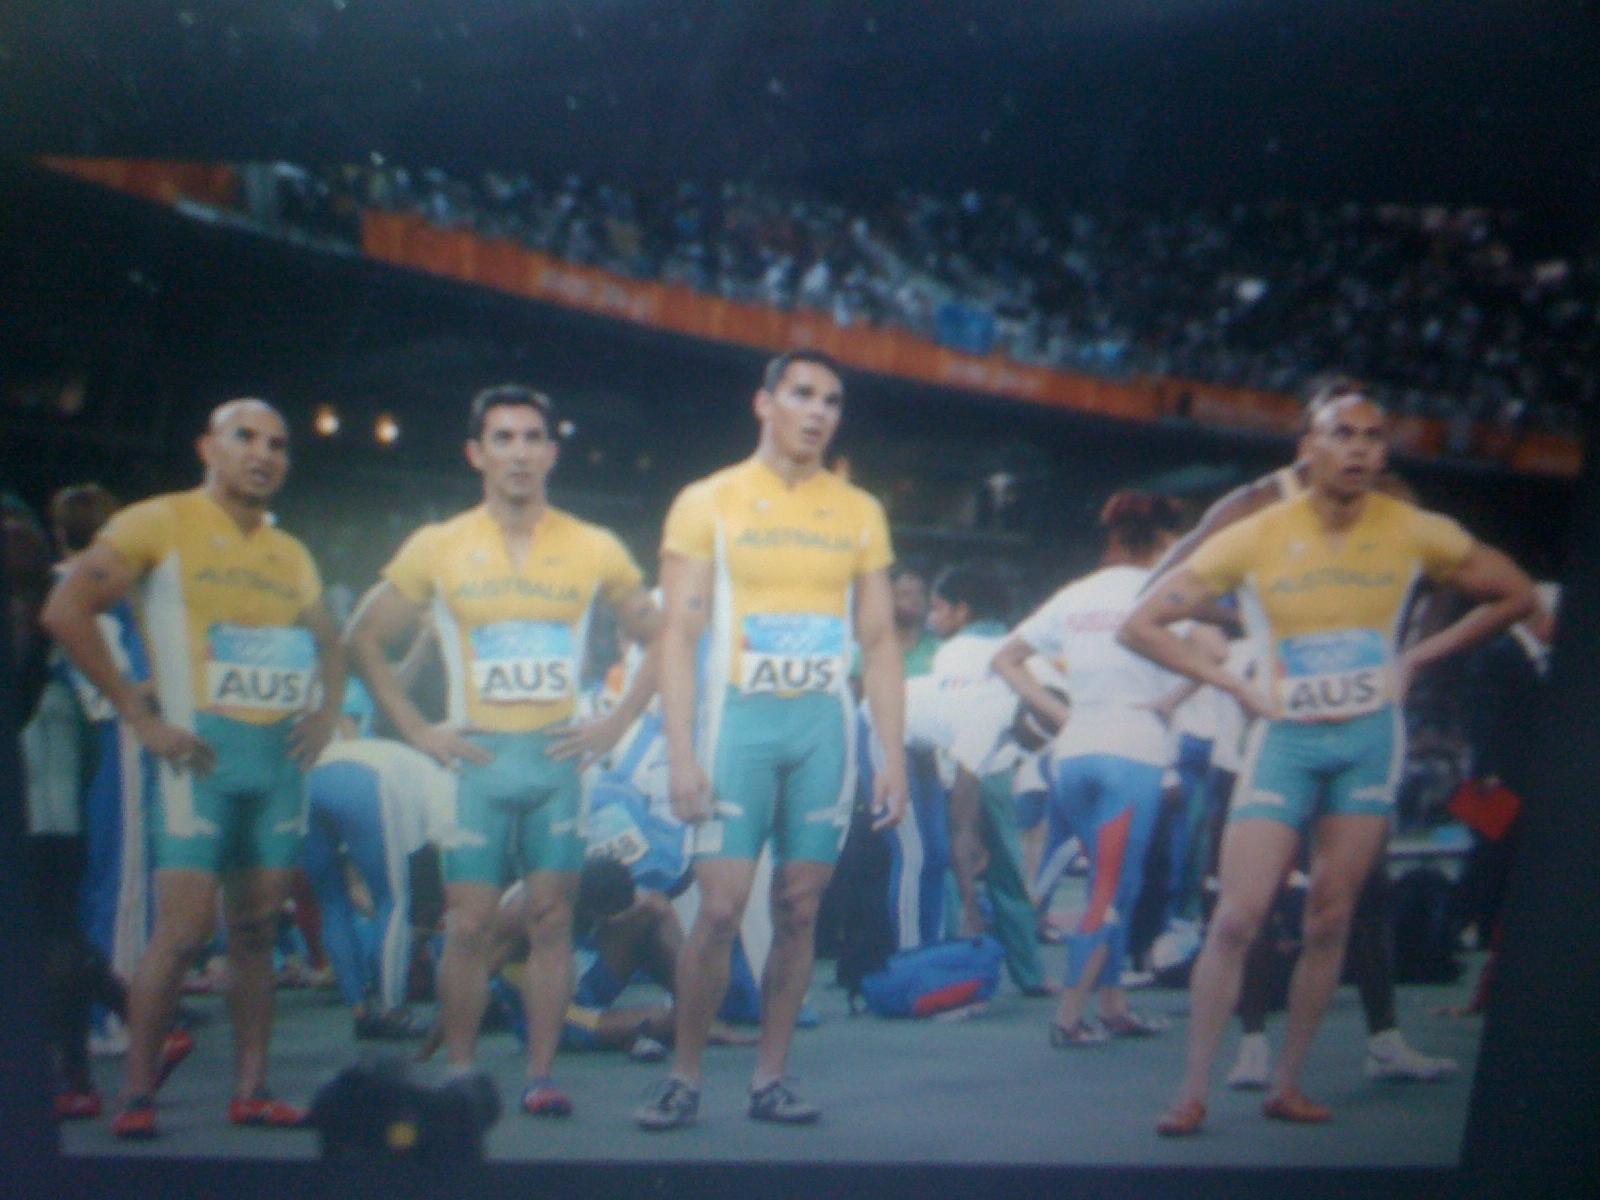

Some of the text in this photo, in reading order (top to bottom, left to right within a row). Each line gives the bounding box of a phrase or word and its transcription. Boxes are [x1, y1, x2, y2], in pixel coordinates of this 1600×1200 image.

[215, 668, 302, 703] AUS
[484, 661, 568, 694] AUS
[750, 657, 834, 690] AUS
[1288, 671, 1377, 711] AUS
